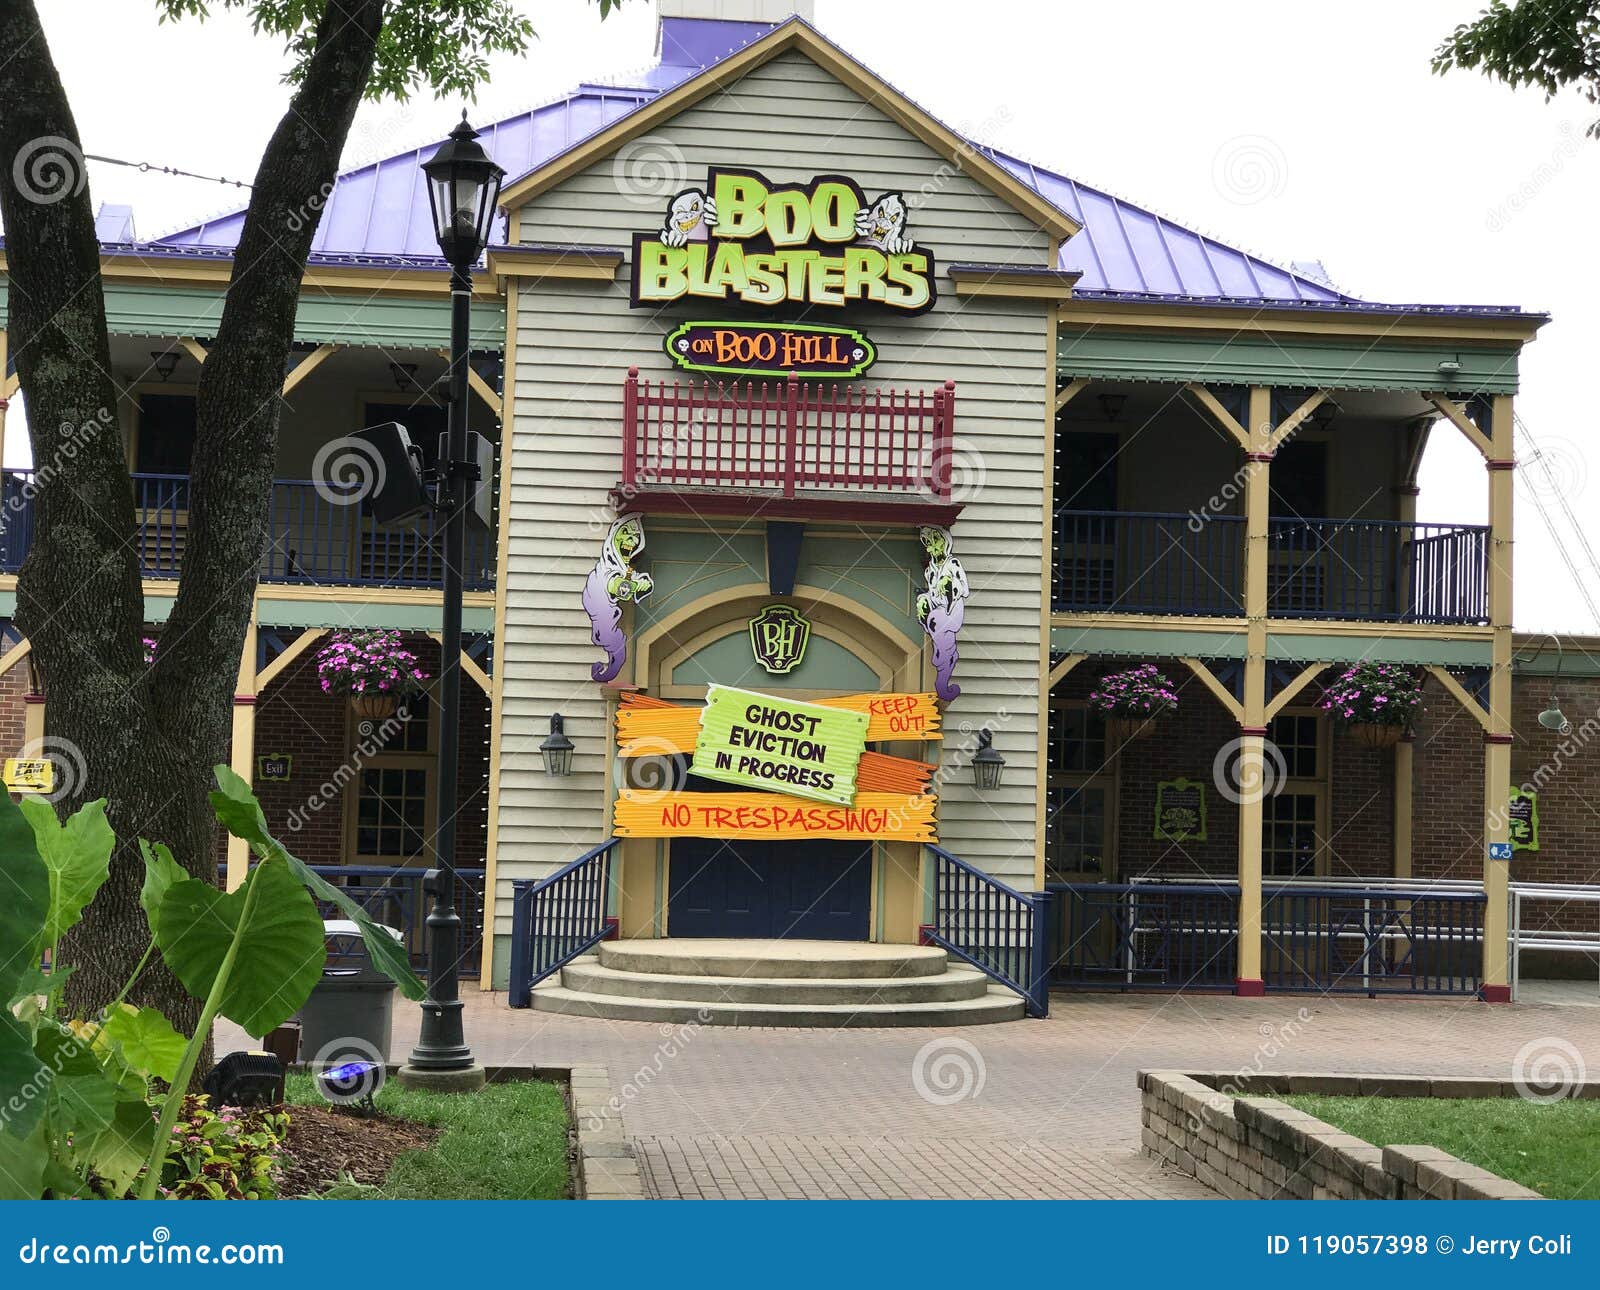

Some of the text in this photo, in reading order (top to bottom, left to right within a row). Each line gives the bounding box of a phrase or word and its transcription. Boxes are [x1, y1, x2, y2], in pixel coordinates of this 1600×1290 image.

[711, 172, 861, 247] BOO
[638, 240, 931, 308] BLASTERS
[692, 330, 849, 367] ON BOO HILL
[761, 618, 798, 660] BH
[745, 704, 822, 736] GHOST
[869, 696, 919, 716] KEEP
[890, 713, 926, 733] OUT!
[728, 725, 827, 763] EVICTION
[714, 751, 836, 790] IN PROGRESS
[662, 804, 889, 833] NO TRESPASSING!
